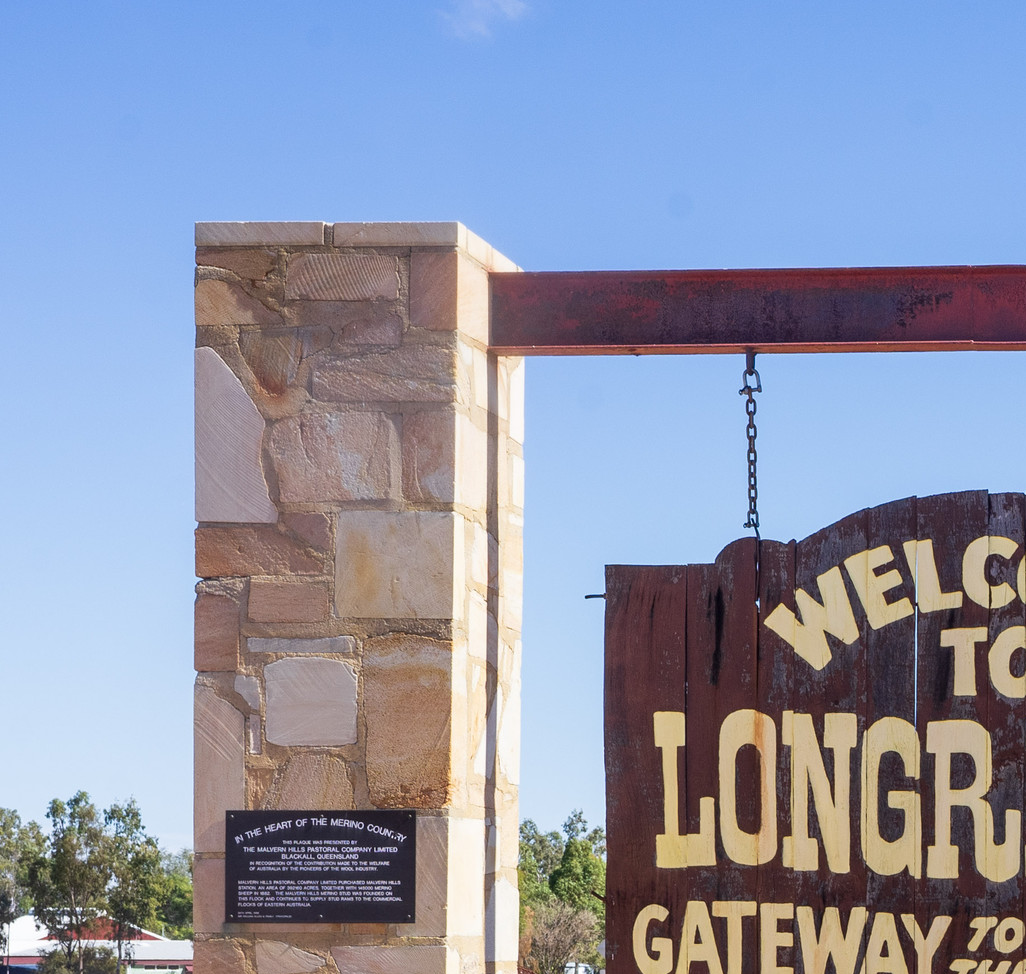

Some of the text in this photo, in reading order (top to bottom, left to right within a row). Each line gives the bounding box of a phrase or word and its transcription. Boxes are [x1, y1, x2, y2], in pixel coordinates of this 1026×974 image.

[234, 835, 244, 844] IN
[245, 829, 262, 839] THE
[265, 820, 292, 833] HEART
[296, 818, 307, 827] OF
[311, 818, 327, 826] THE
[330, 818, 364, 830] MERINO
[967, 916, 1026, 952] TO
